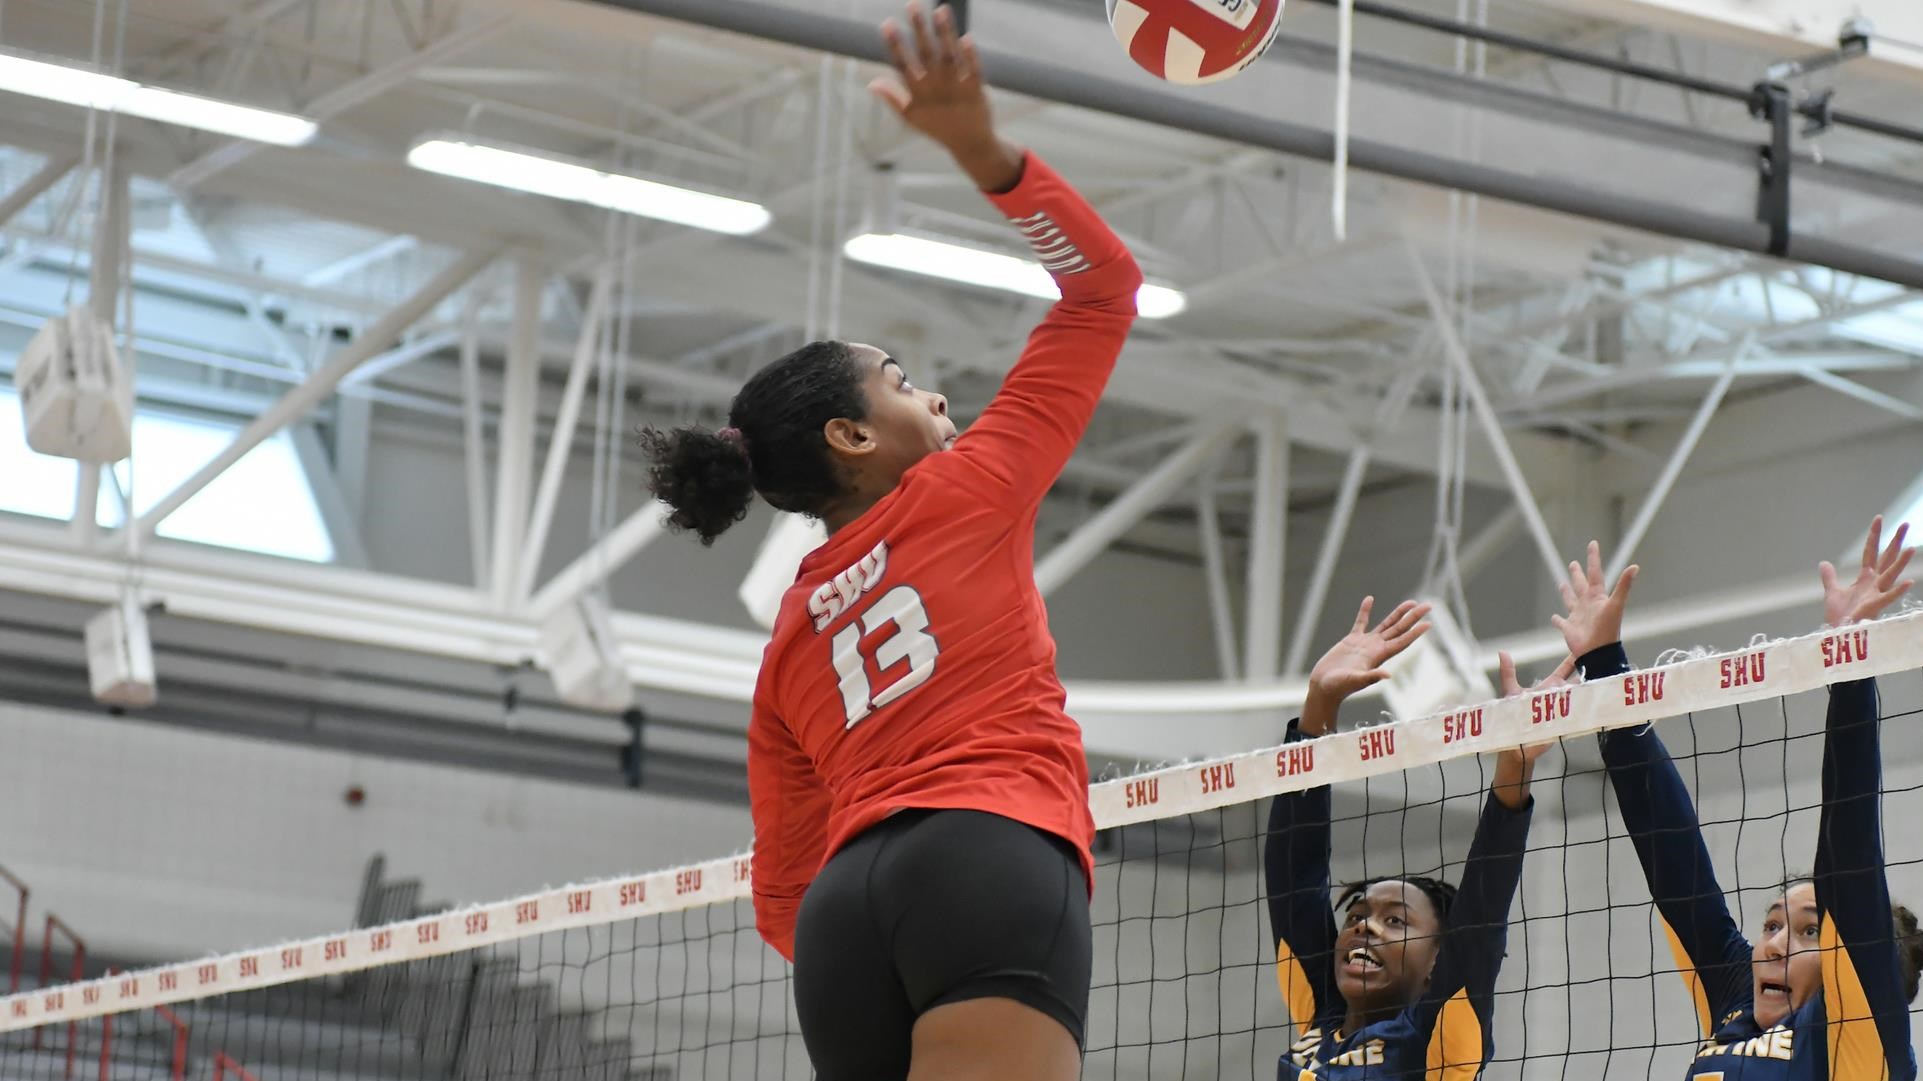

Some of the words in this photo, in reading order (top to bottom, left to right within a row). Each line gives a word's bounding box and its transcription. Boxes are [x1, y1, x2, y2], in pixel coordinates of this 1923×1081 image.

[808, 540, 889, 634] SHU
[831, 584, 940, 730] 13
[1125, 777, 1160, 809] SHU
[1199, 762, 1236, 795] SHU
[1275, 745, 1315, 779] SHU
[1358, 728, 1396, 762] SHU
[1441, 708, 1483, 745] SHU
[1530, 689, 1572, 725] SHU
[1622, 671, 1666, 707] SHU
[1718, 650, 1766, 690] SHU
[1820, 629, 1869, 668] SHU
[567, 890, 592, 913] SHU
[619, 881, 647, 906] SHU
[675, 869, 703, 896] SHU
[733, 859, 750, 883] SH
